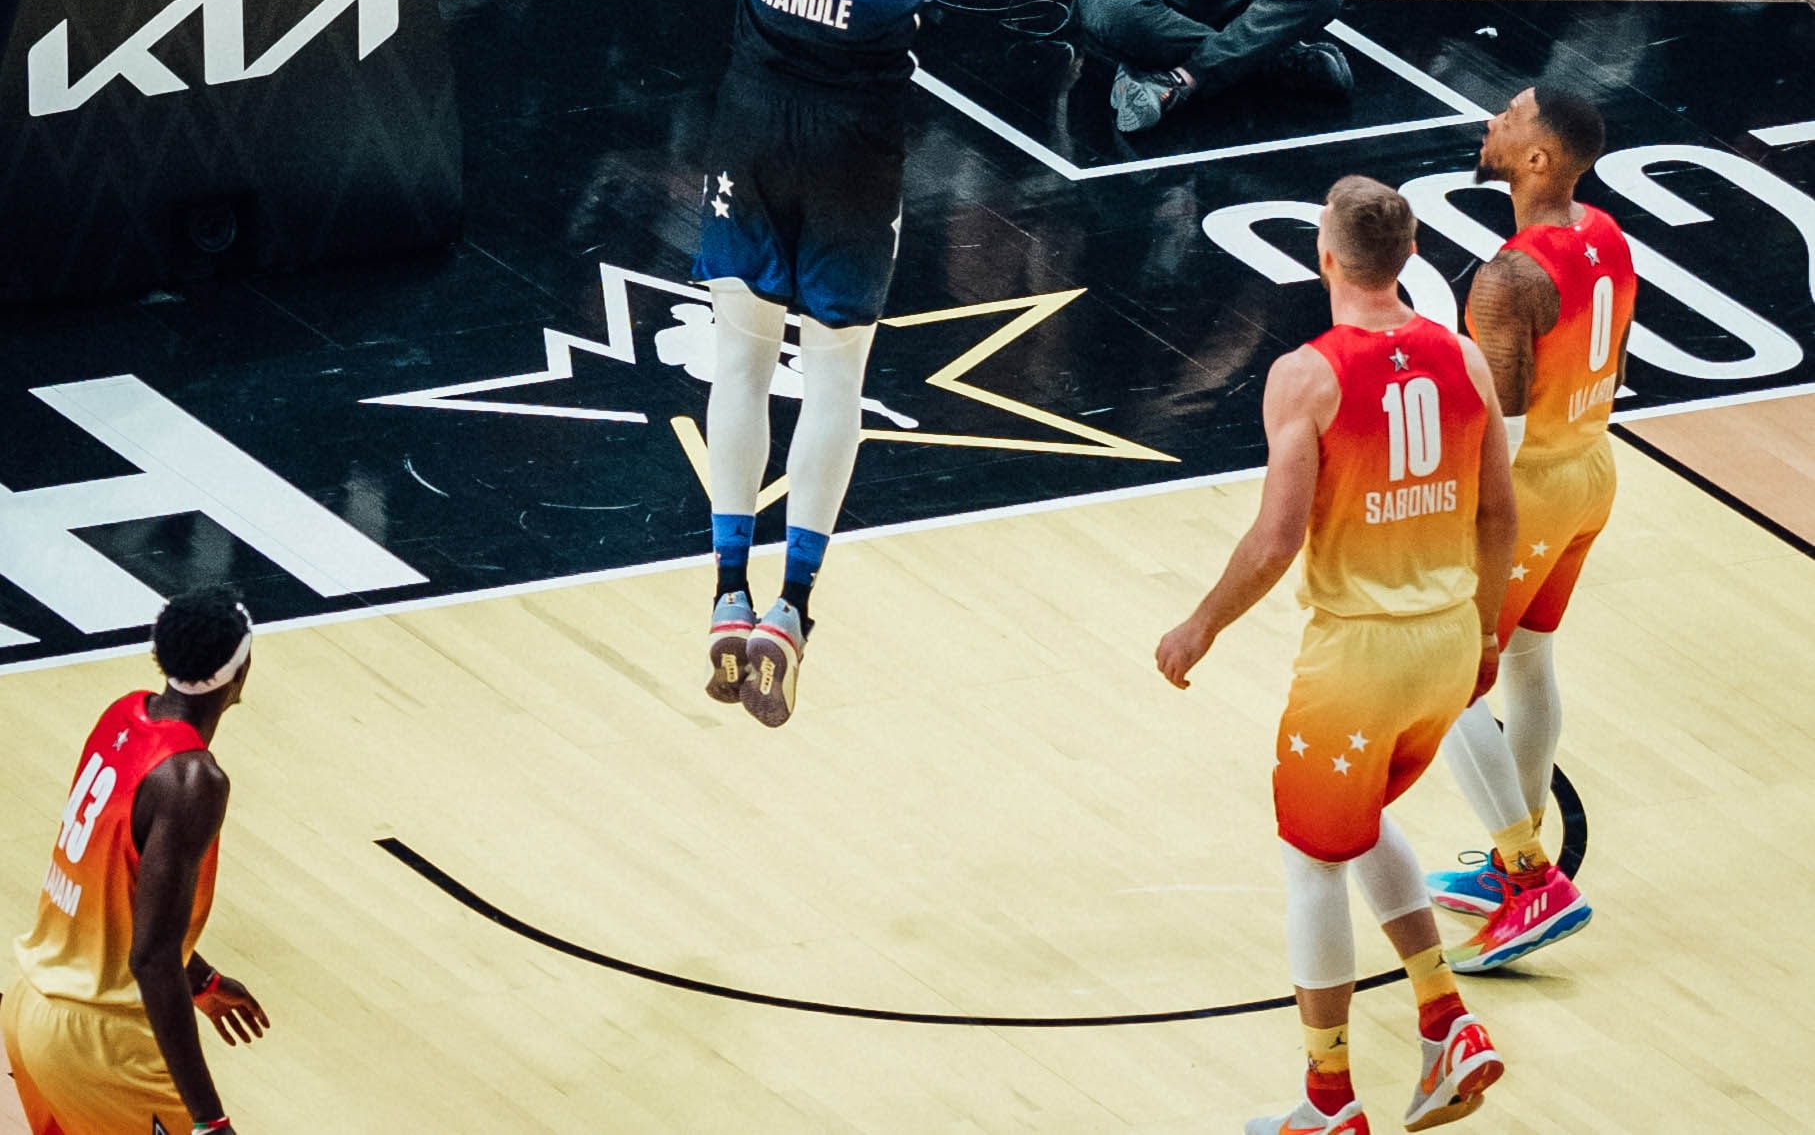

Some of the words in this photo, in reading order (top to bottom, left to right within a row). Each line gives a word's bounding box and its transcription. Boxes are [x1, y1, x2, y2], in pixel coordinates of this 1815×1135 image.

[1589, 275, 1614, 373] 0
[1381, 376, 1442, 482] 10
[1365, 479, 1457, 525] SABONIS
[58, 751, 117, 864] 43
